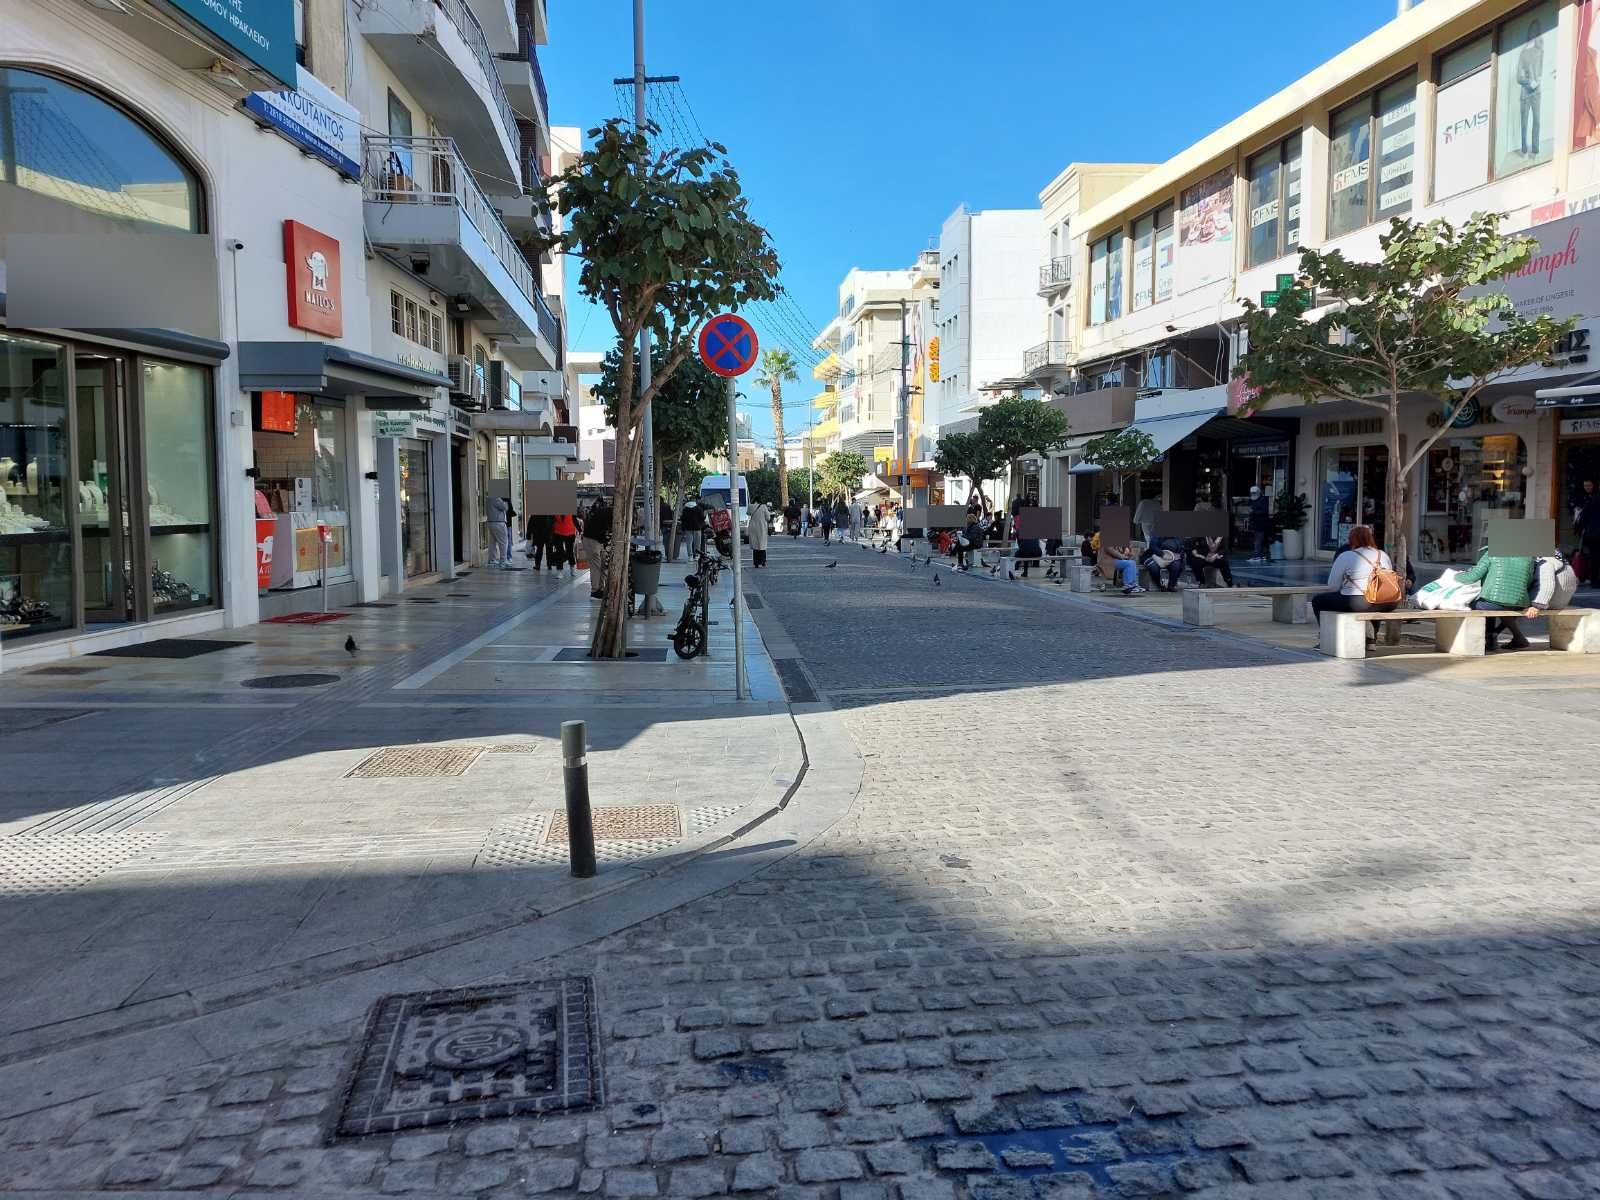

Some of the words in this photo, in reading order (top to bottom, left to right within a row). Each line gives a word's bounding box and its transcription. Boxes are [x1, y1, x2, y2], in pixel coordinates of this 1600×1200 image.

[200, 0, 228, 19] ΟΜΟΥ
[229, 12, 270, 51] ΗΡΑΚΛΕΙΟΥ
[287, 91, 344, 142] KOUTANTOS
[1454, 109, 1489, 135] FMS
